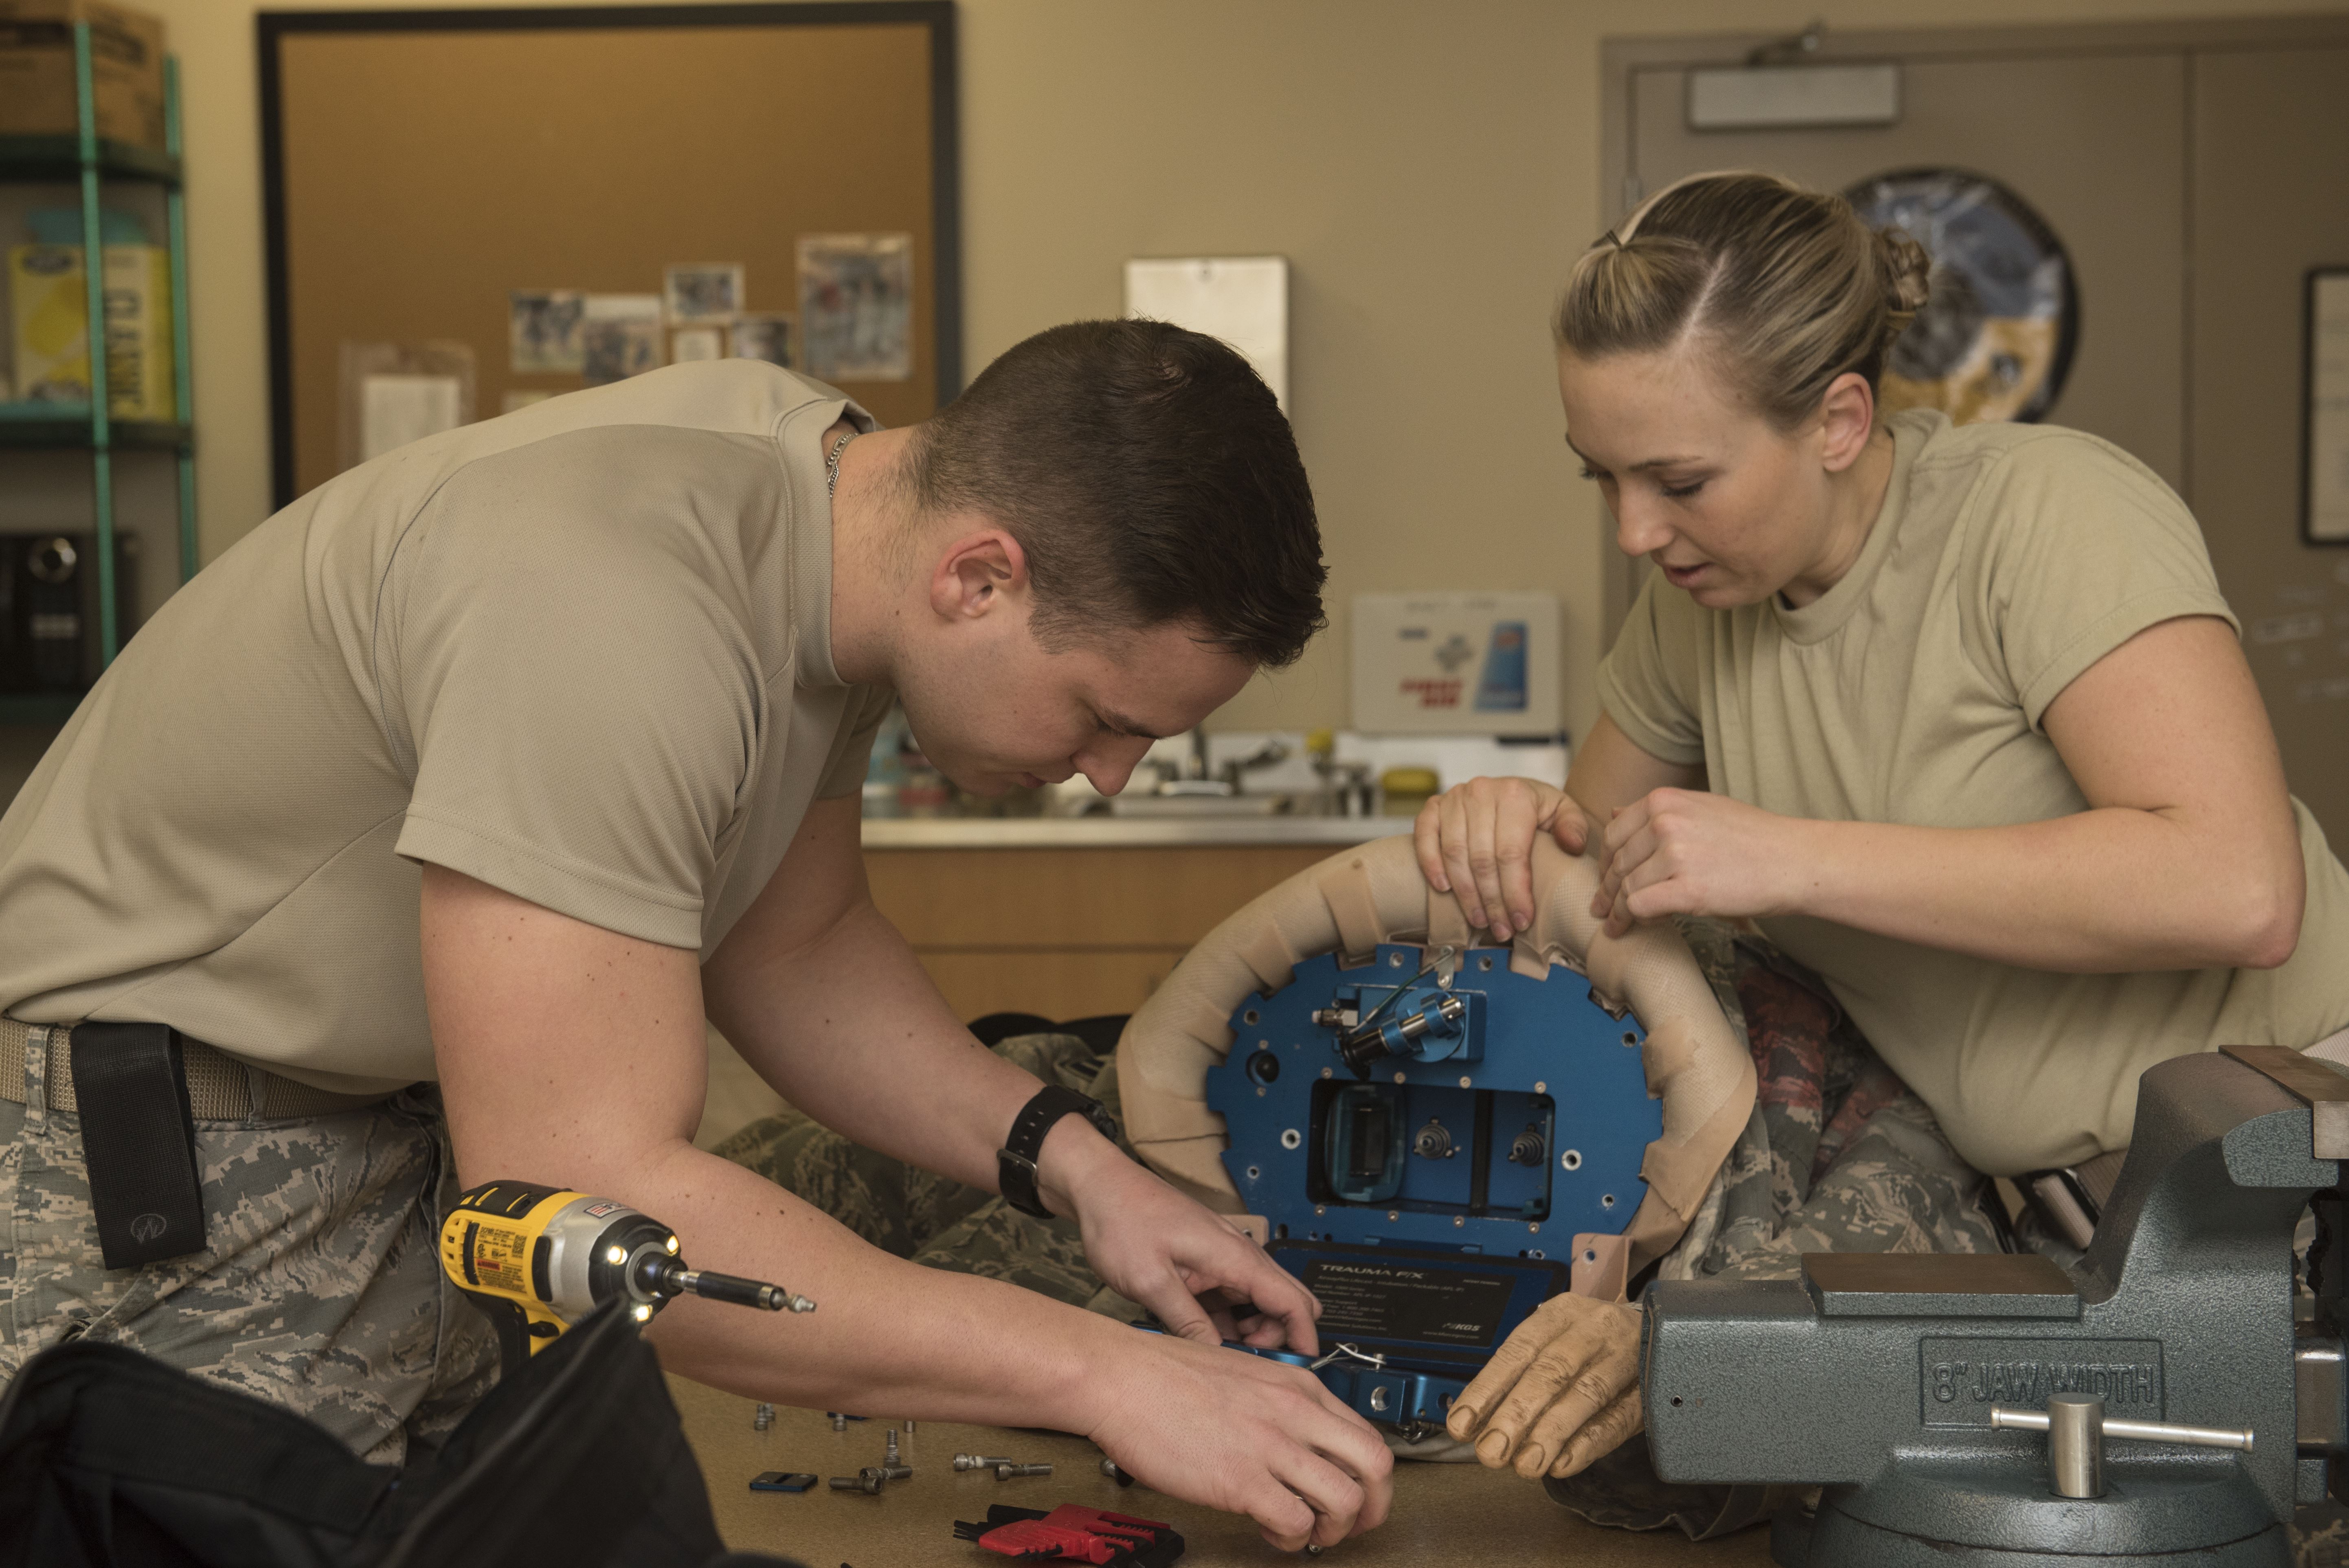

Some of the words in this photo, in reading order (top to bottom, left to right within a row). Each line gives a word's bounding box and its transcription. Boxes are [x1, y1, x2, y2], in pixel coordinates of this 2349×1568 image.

[1320, 1264, 1391, 1275] TRAUMA
[1932, 1362, 1968, 1403] 8"
[1971, 1362, 2037, 1403] JAW
[2049, 1364, 2154, 1404] WIDTH
